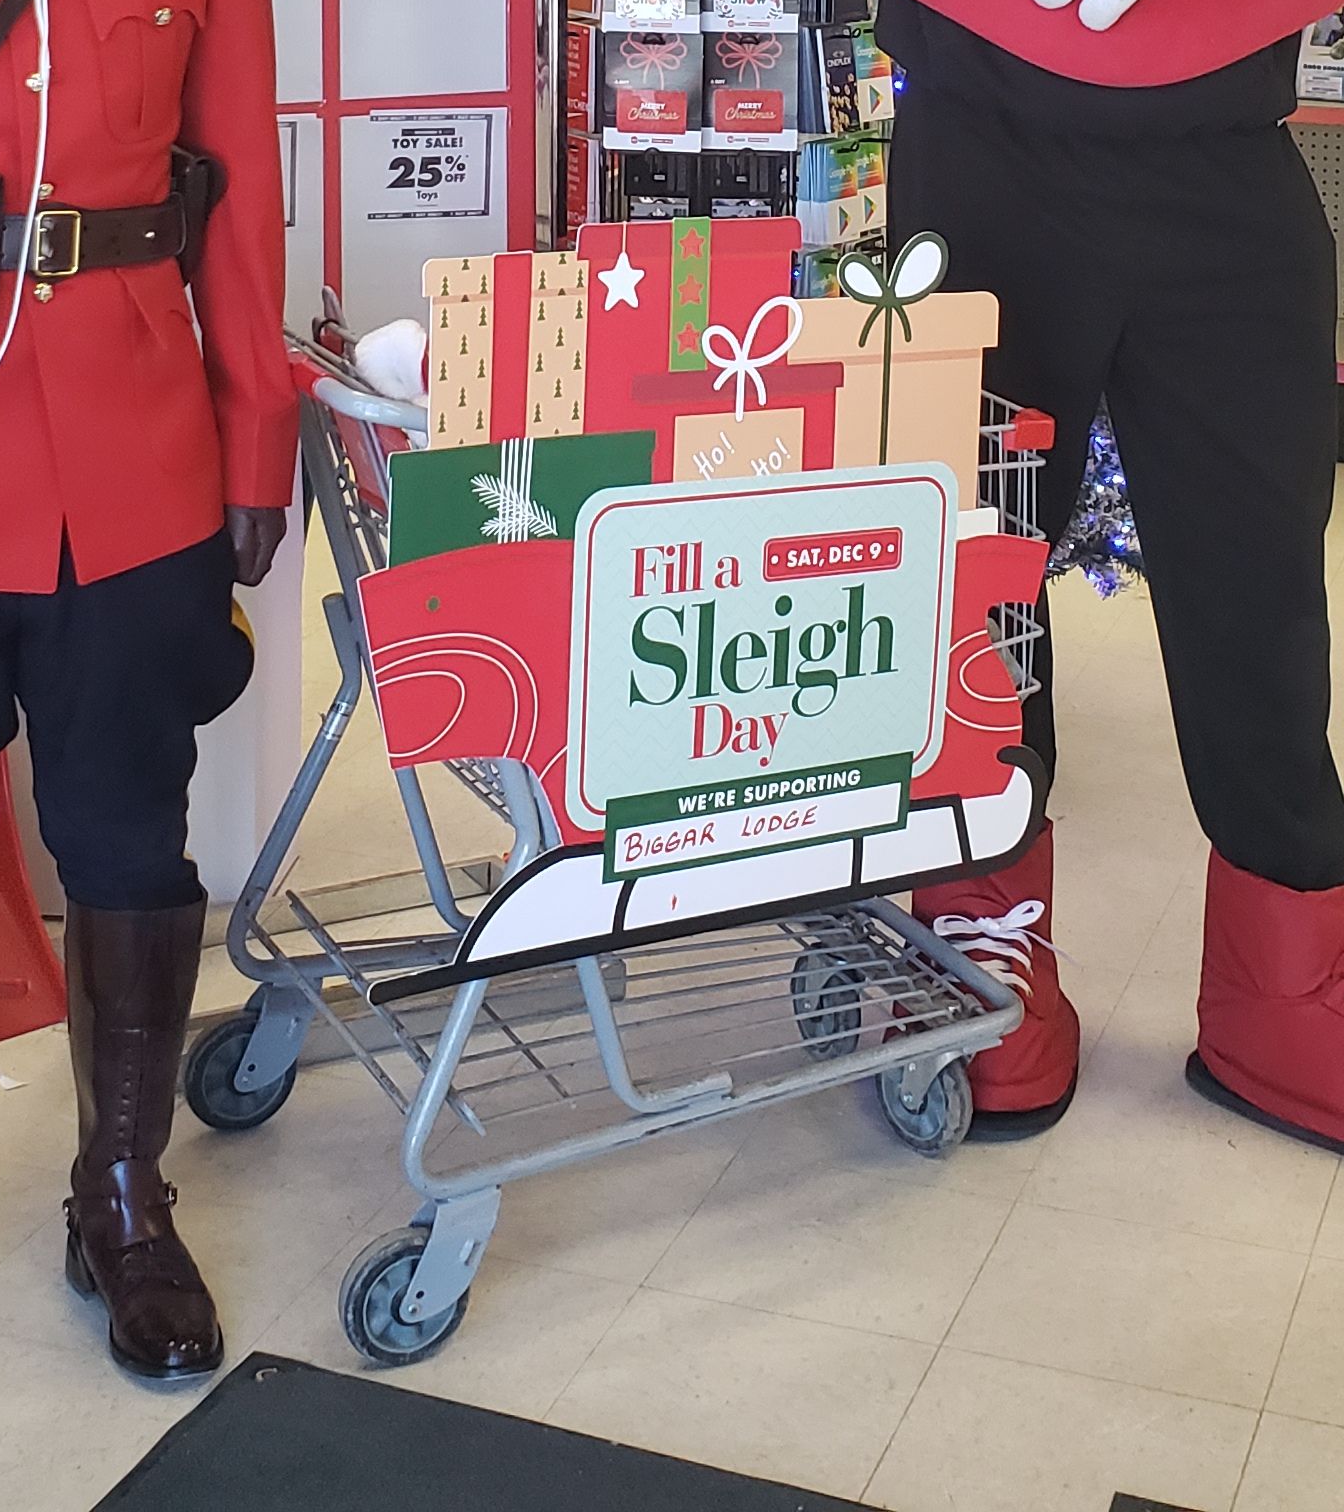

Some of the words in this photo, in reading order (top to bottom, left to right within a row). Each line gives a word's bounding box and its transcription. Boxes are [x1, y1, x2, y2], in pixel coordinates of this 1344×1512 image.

[628, 107, 680, 121] Christmas
[725, 107, 776, 121] Christmas
[392, 139, 419, 149] TOY
[425, 137, 463, 148] SALE!
[416, 190, 438, 201] Toys
[445, 173, 465, 183] OFF
[693, 432, 735, 481] Ho!
[629, 541, 704, 598] Fill
[713, 555, 743, 588] a
[787, 549, 825, 568] SAT,
[829, 544, 863, 562] DEC
[870, 542, 883, 560] 9
[628, 583, 898, 718] Sleigh
[688, 703, 789, 767] Day
[678, 788, 736, 815] WE'RE
[744, 769, 861, 804] SUPPORTING
[623, 822, 716, 863] BIGGAR
[741, 805, 819, 837] LODGE
